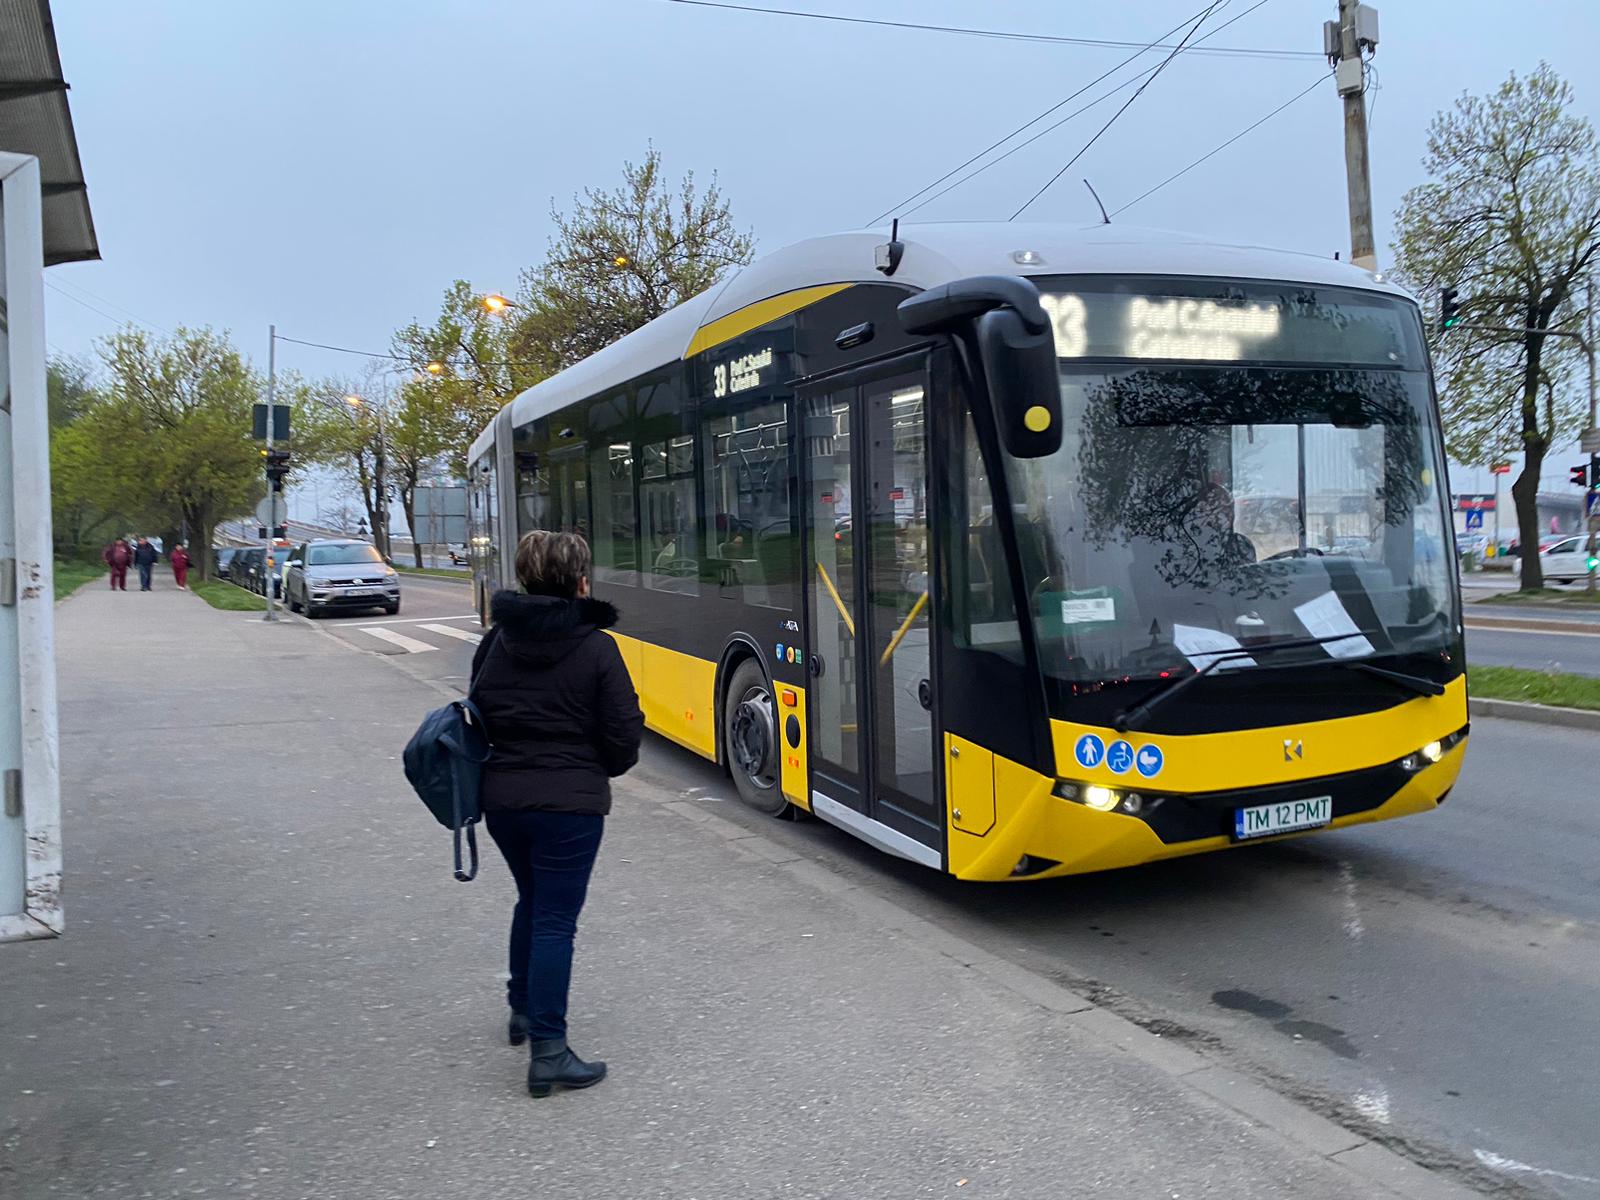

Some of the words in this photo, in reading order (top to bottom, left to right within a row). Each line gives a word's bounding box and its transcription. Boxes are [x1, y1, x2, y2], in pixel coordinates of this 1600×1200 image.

[714, 365, 726, 398] 33
[1246, 808, 1269, 830] TM
[1275, 805, 1290, 825] 12
[1295, 799, 1329, 822] PMT
